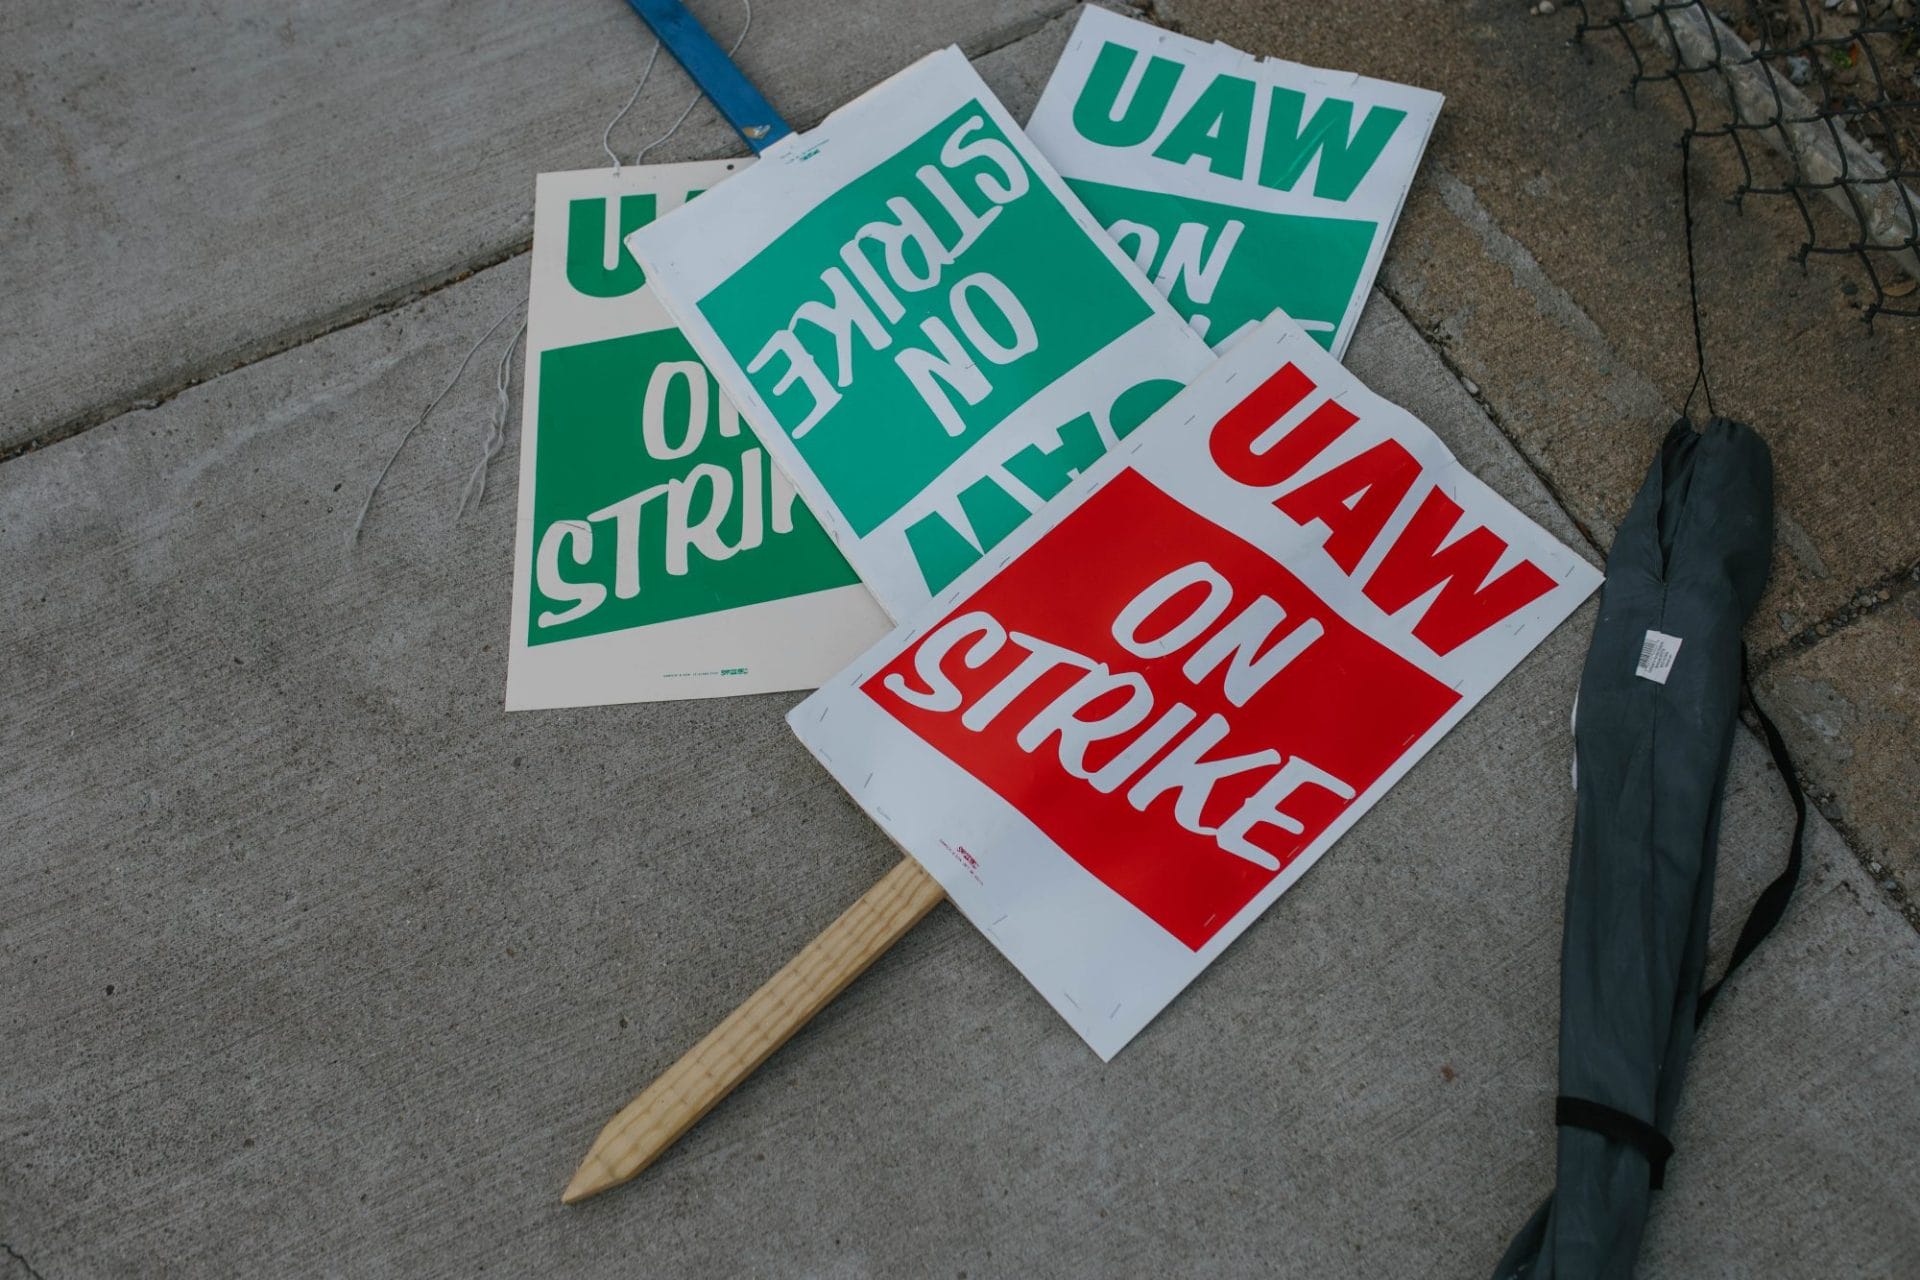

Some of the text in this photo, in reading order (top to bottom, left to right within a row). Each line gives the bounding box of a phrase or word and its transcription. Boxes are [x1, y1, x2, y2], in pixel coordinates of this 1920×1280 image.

[1073, 41, 1407, 202] UAW
[566, 190, 709, 297] U
[747, 115, 1030, 439] STRIKE
[894, 272, 1039, 437] ON
[1208, 361, 1558, 657] UAW
[1111, 561, 1325, 707] ON
[884, 610, 1356, 872] STRIKE
